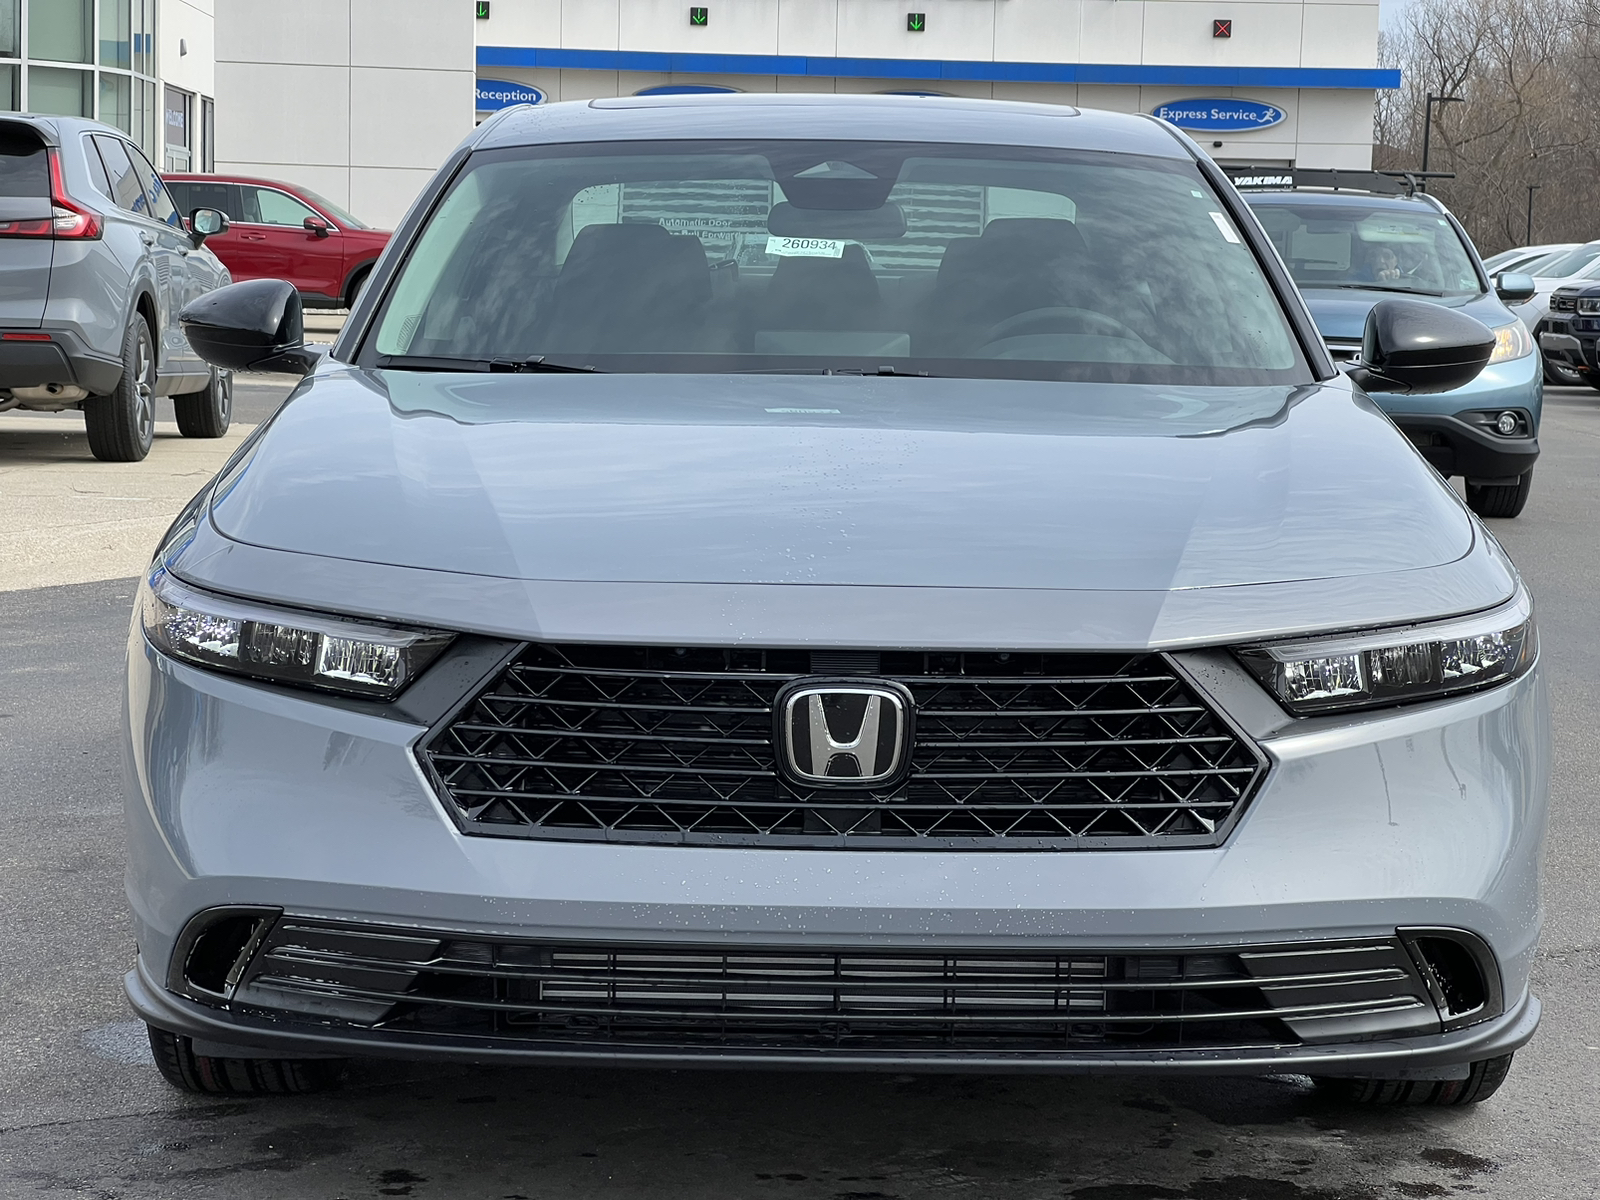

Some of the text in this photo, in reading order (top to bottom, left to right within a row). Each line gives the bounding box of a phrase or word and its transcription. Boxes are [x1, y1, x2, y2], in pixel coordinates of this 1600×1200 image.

[476, 88, 537, 103] Reception
[1160, 107, 1257, 121] Express Service
[1234, 176, 1293, 186] YAKIMA
[659, 218, 733, 228] Automatic Door
[782, 238, 837, 250] 260934
